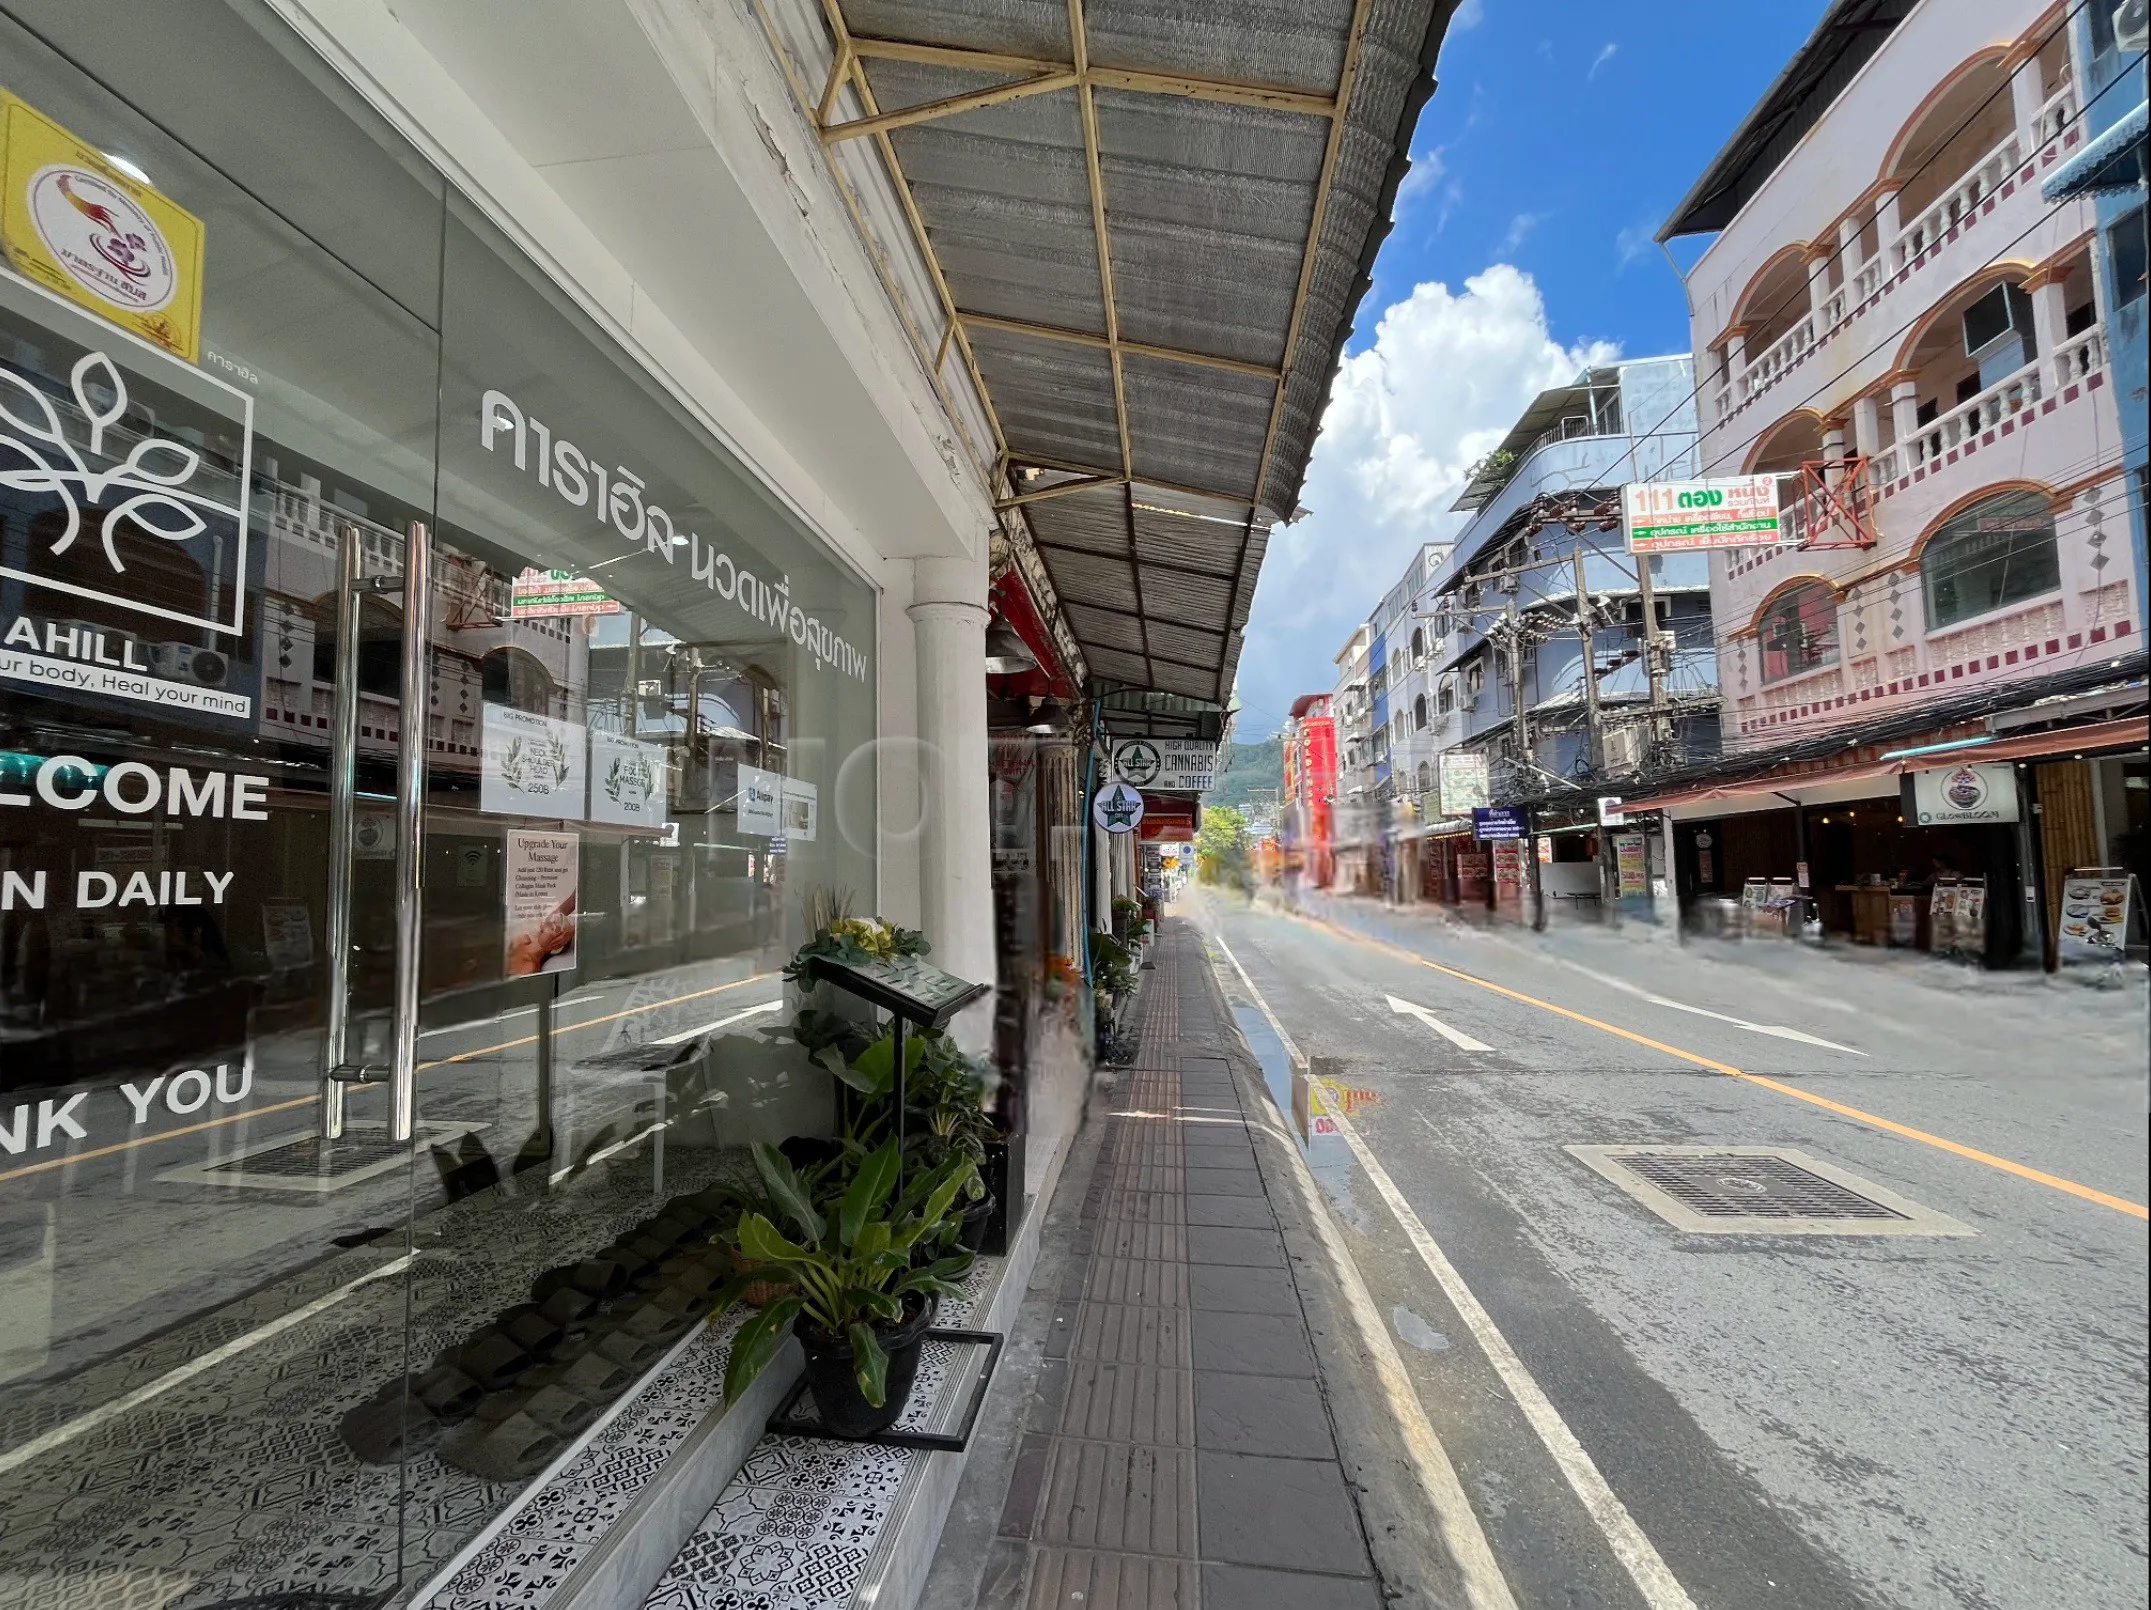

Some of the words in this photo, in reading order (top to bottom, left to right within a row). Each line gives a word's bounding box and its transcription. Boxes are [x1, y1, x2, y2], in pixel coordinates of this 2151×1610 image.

[1678, 489, 1723, 509] ตอง
[30, 659, 94, 688] body,
[102, 673, 149, 696] Heal
[155, 686, 199, 704] your
[202, 694, 246, 714] mind
[1165, 740, 1181, 751] HIGH
[1184, 740, 1214, 751] QUALITY
[1164, 754, 1213, 772] CANNABIS
[1178, 775, 1213, 789] COFFEE
[1101, 800, 1115, 812] ALL
[1116, 800, 1136, 812] STAR
[517, 838, 549, 851] Upgrade
[550, 839, 568, 850] Your
[527, 852, 559, 864] Massage
[1, 870, 47, 910] N
[76, 870, 234, 909] DAILY
[119, 1056, 253, 1124] YOU
